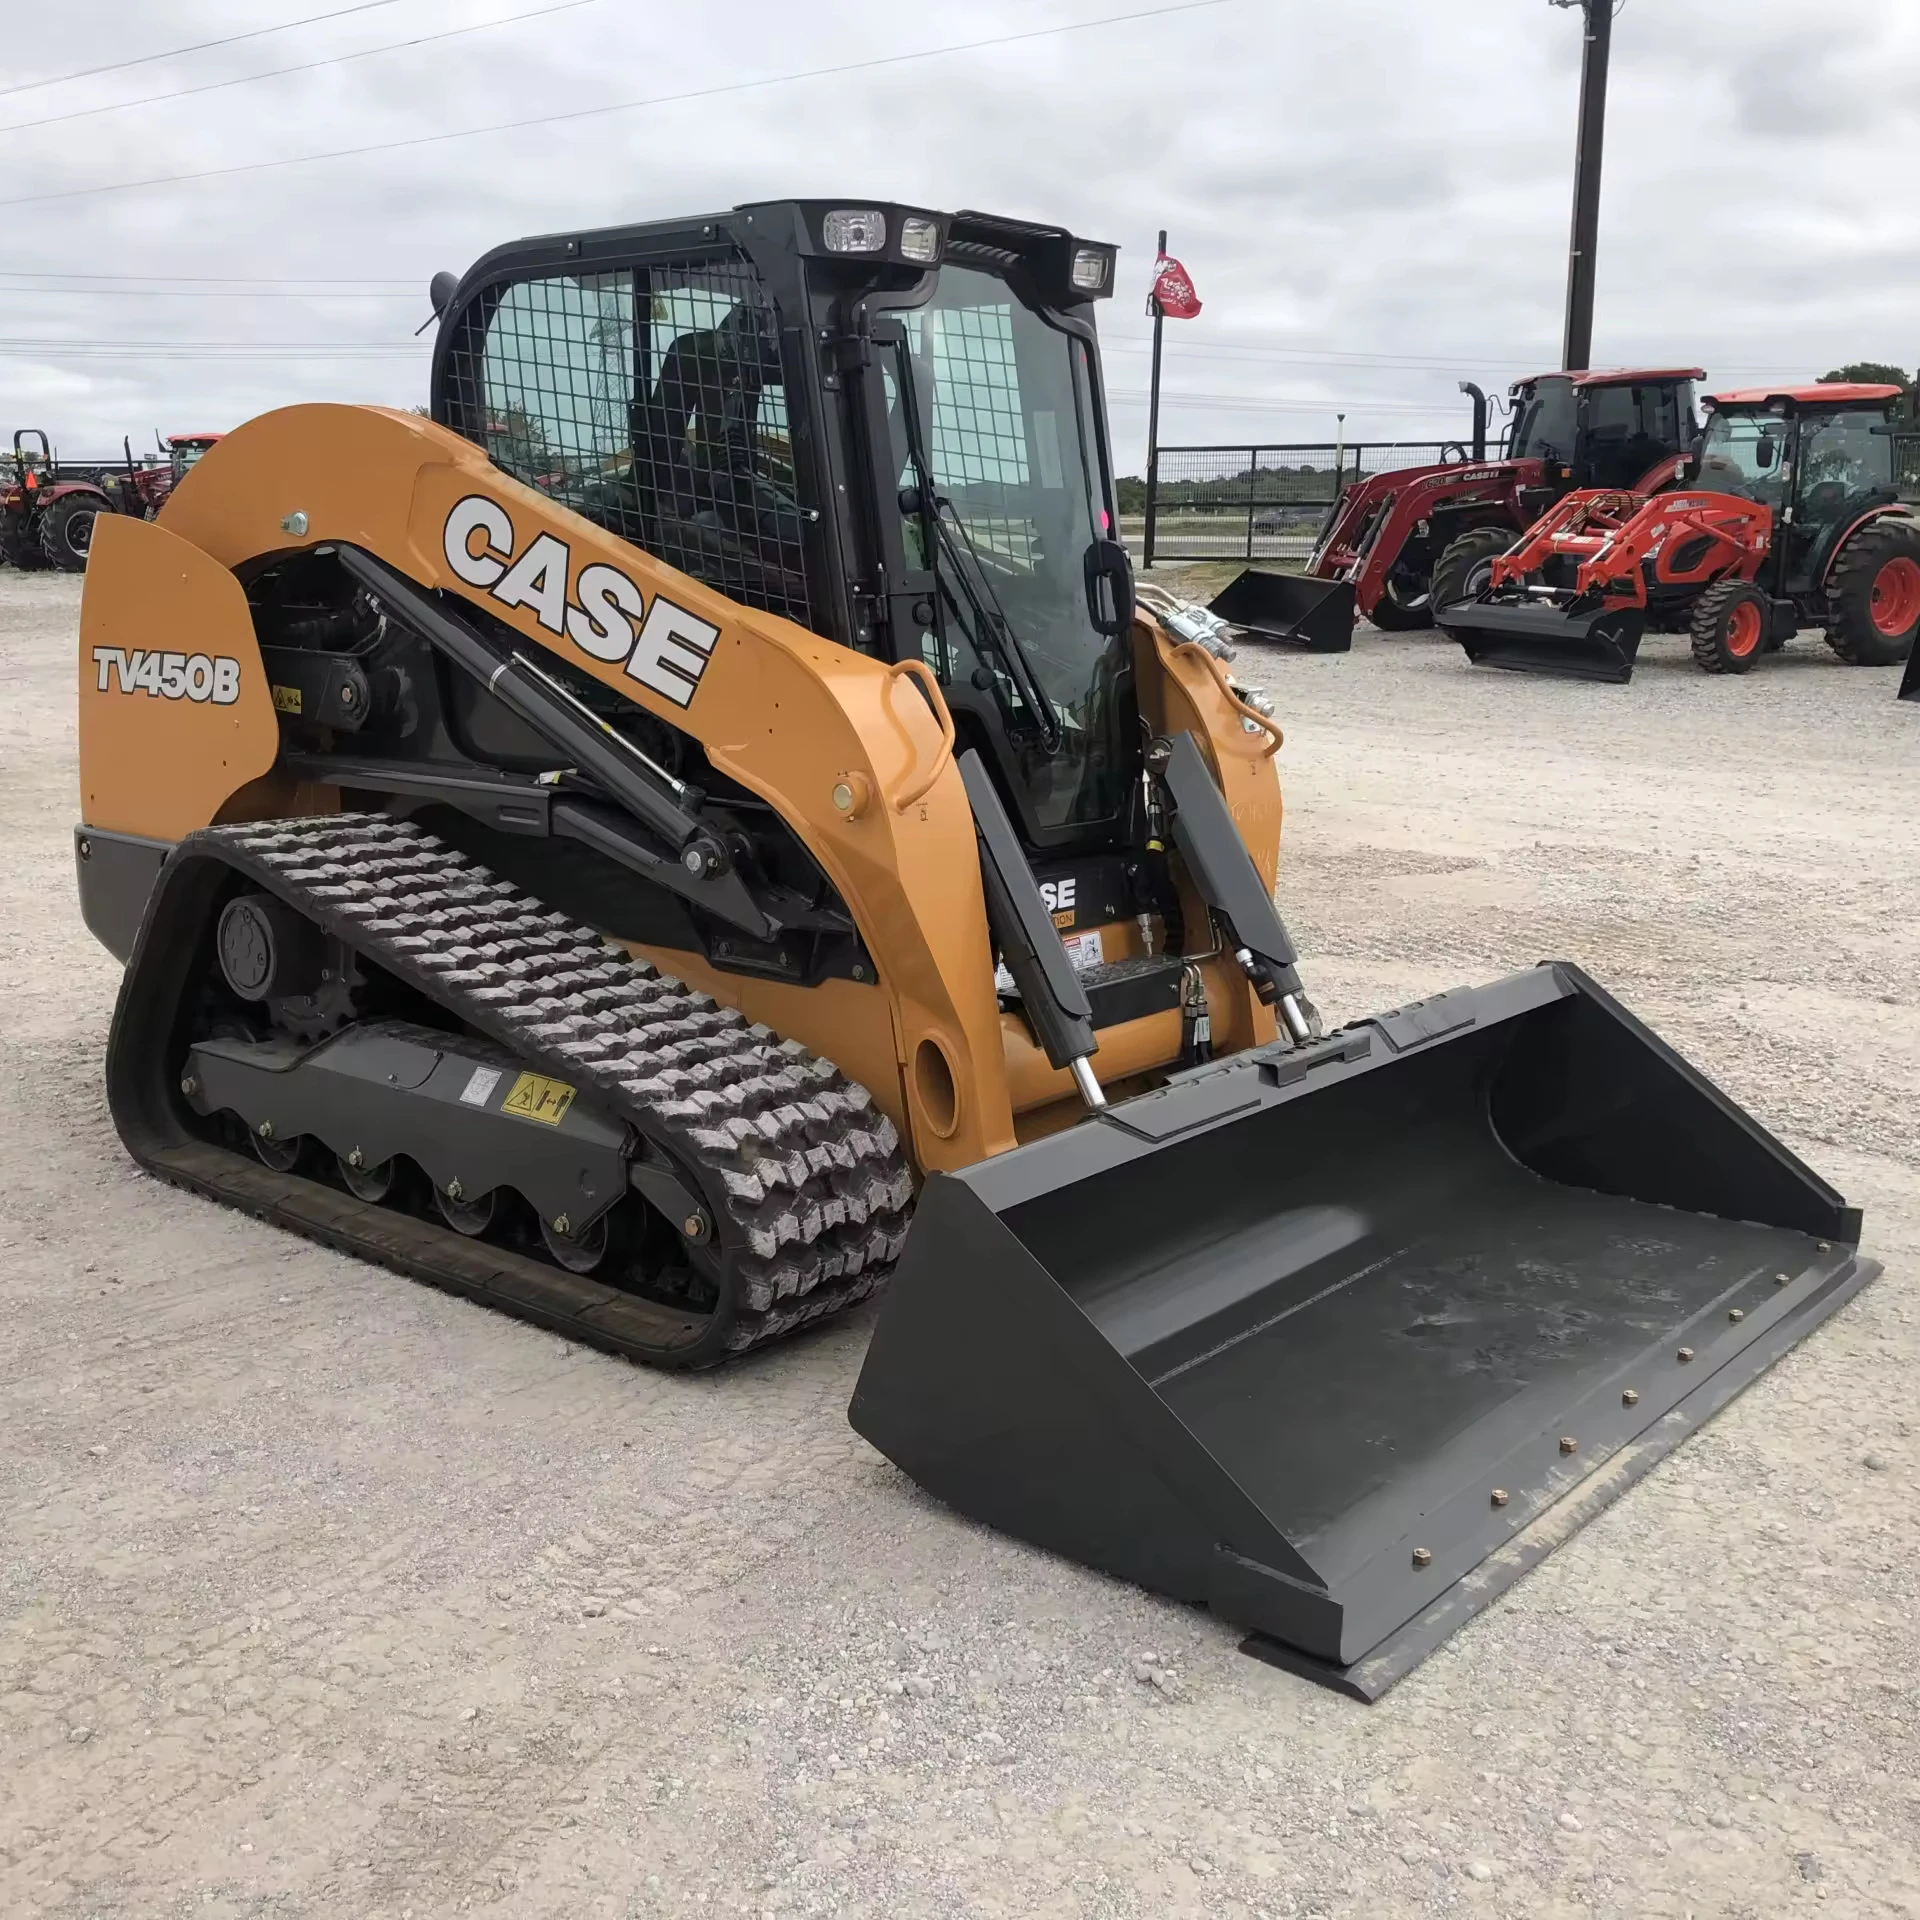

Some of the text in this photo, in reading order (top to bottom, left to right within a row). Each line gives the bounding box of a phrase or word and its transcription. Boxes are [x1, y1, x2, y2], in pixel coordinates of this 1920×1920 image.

[443, 494, 722, 710] CASE
[92, 646, 241, 705] TV450B
[1039, 878, 1076, 912] SE
